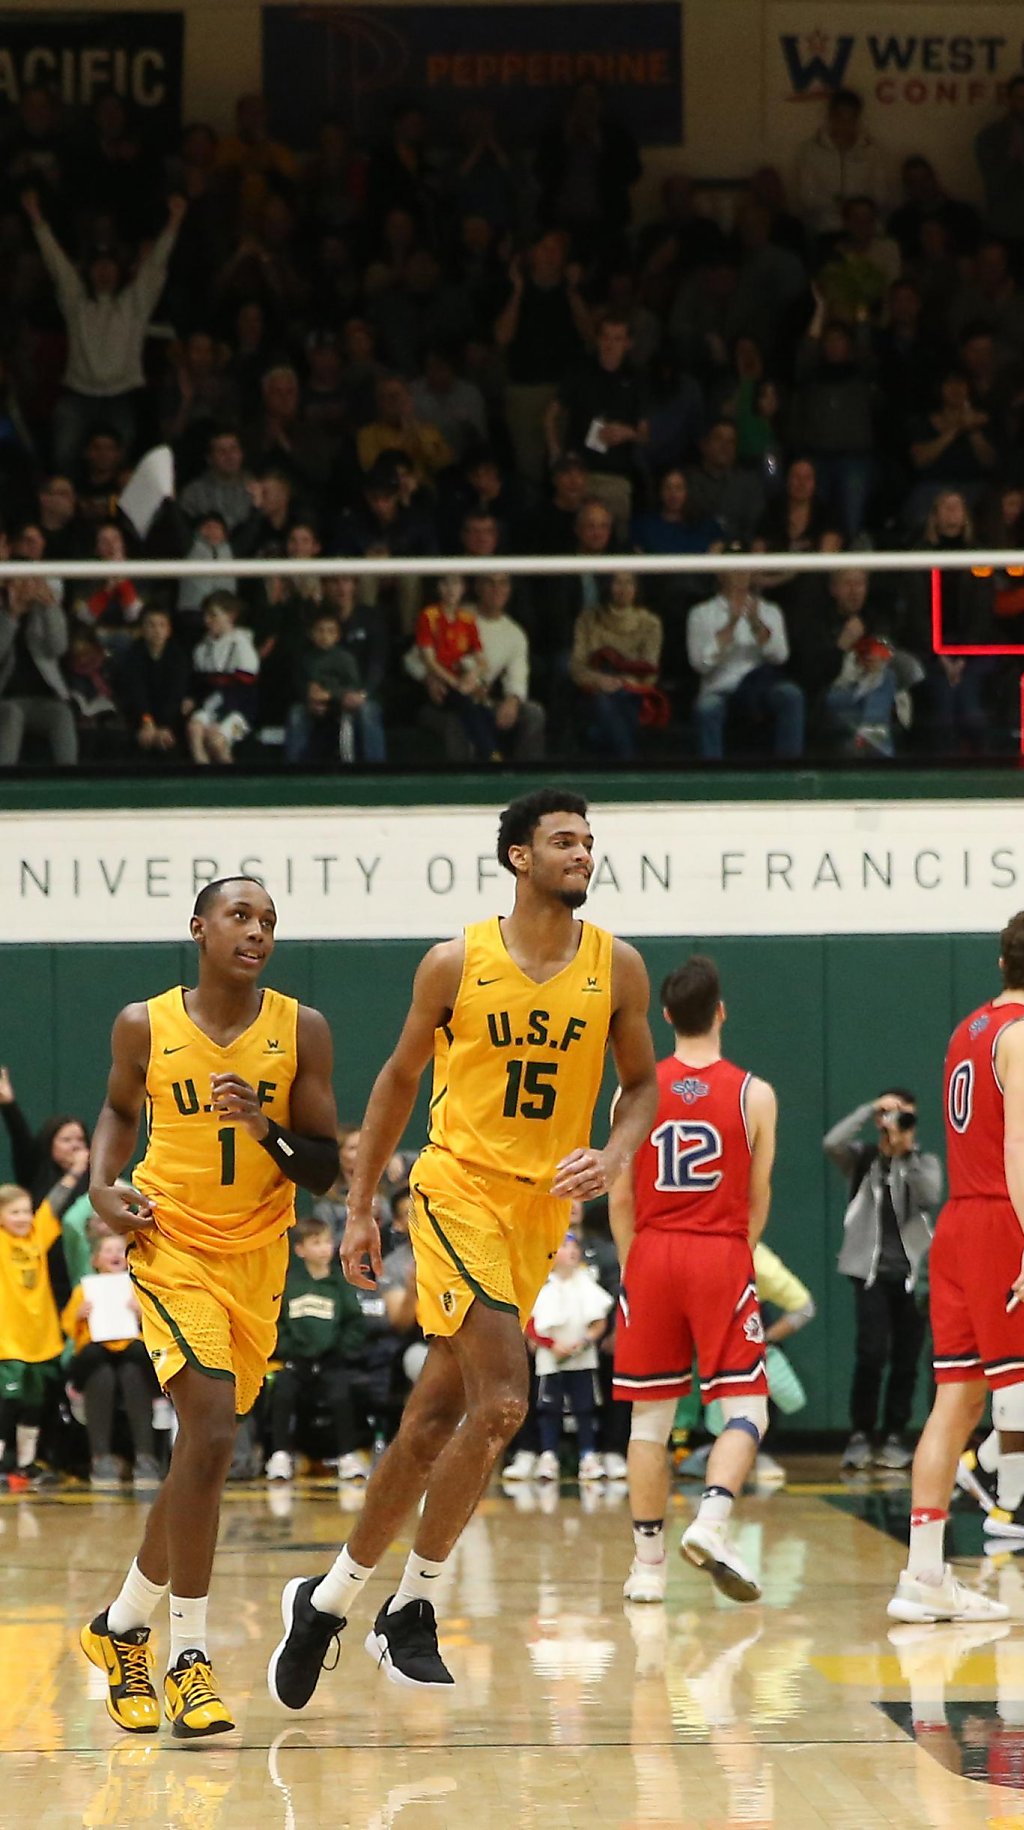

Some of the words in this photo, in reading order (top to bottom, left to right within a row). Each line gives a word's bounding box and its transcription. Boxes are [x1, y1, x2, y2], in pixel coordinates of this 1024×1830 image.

[867, 36, 1005, 72] WEST
[427, 855, 498, 896] OF
[590, 854, 670, 892] AN
[502, 1059, 559, 1121] 15
[948, 1058, 975, 1134] 0
[217, 1127, 236, 1186] 1
[651, 1119, 722, 1192] 12
